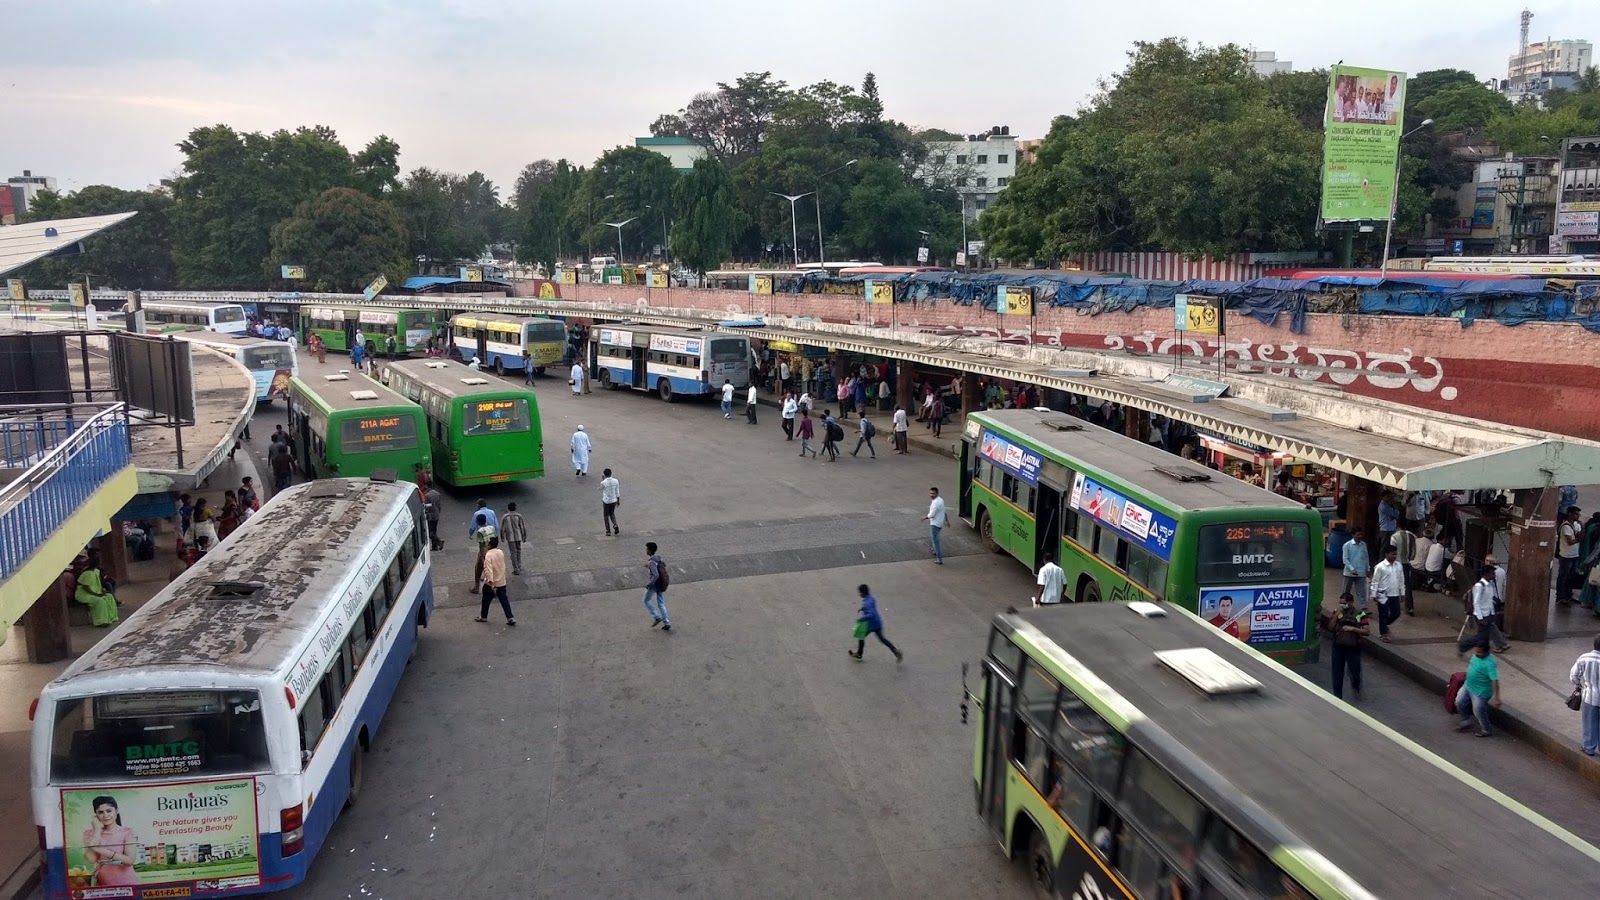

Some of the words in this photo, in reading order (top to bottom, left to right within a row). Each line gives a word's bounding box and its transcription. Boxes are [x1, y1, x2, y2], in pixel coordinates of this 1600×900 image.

[1176, 313, 1185, 325] 24
[360, 420, 378, 429] 211A
[486, 418, 511, 426] BMTC
[364, 433, 393, 442] BMTC
[1226, 527, 1251, 540] 225C
[1232, 553, 1274, 565] BMTC
[1267, 589, 1305, 600] ASTRAL
[1270, 599, 1294, 607] PIPES
[1254, 613, 1280, 622] CPVC
[126, 741, 199, 760] BMTC
[126, 754, 200, 765] www.mybmtc.com
[126, 762, 150, 771] Helpline
[157, 793, 229, 813] Banjara's
[152, 820, 170, 828] Pure
[172, 818, 199, 827] Nature
[201, 815, 222, 825] gives
[223, 814, 239, 823] you
[158, 825, 203, 836] Everlasting
[205, 823, 233, 833] Beauty
[143, 888, 190, 898] KA-01-FA-411
